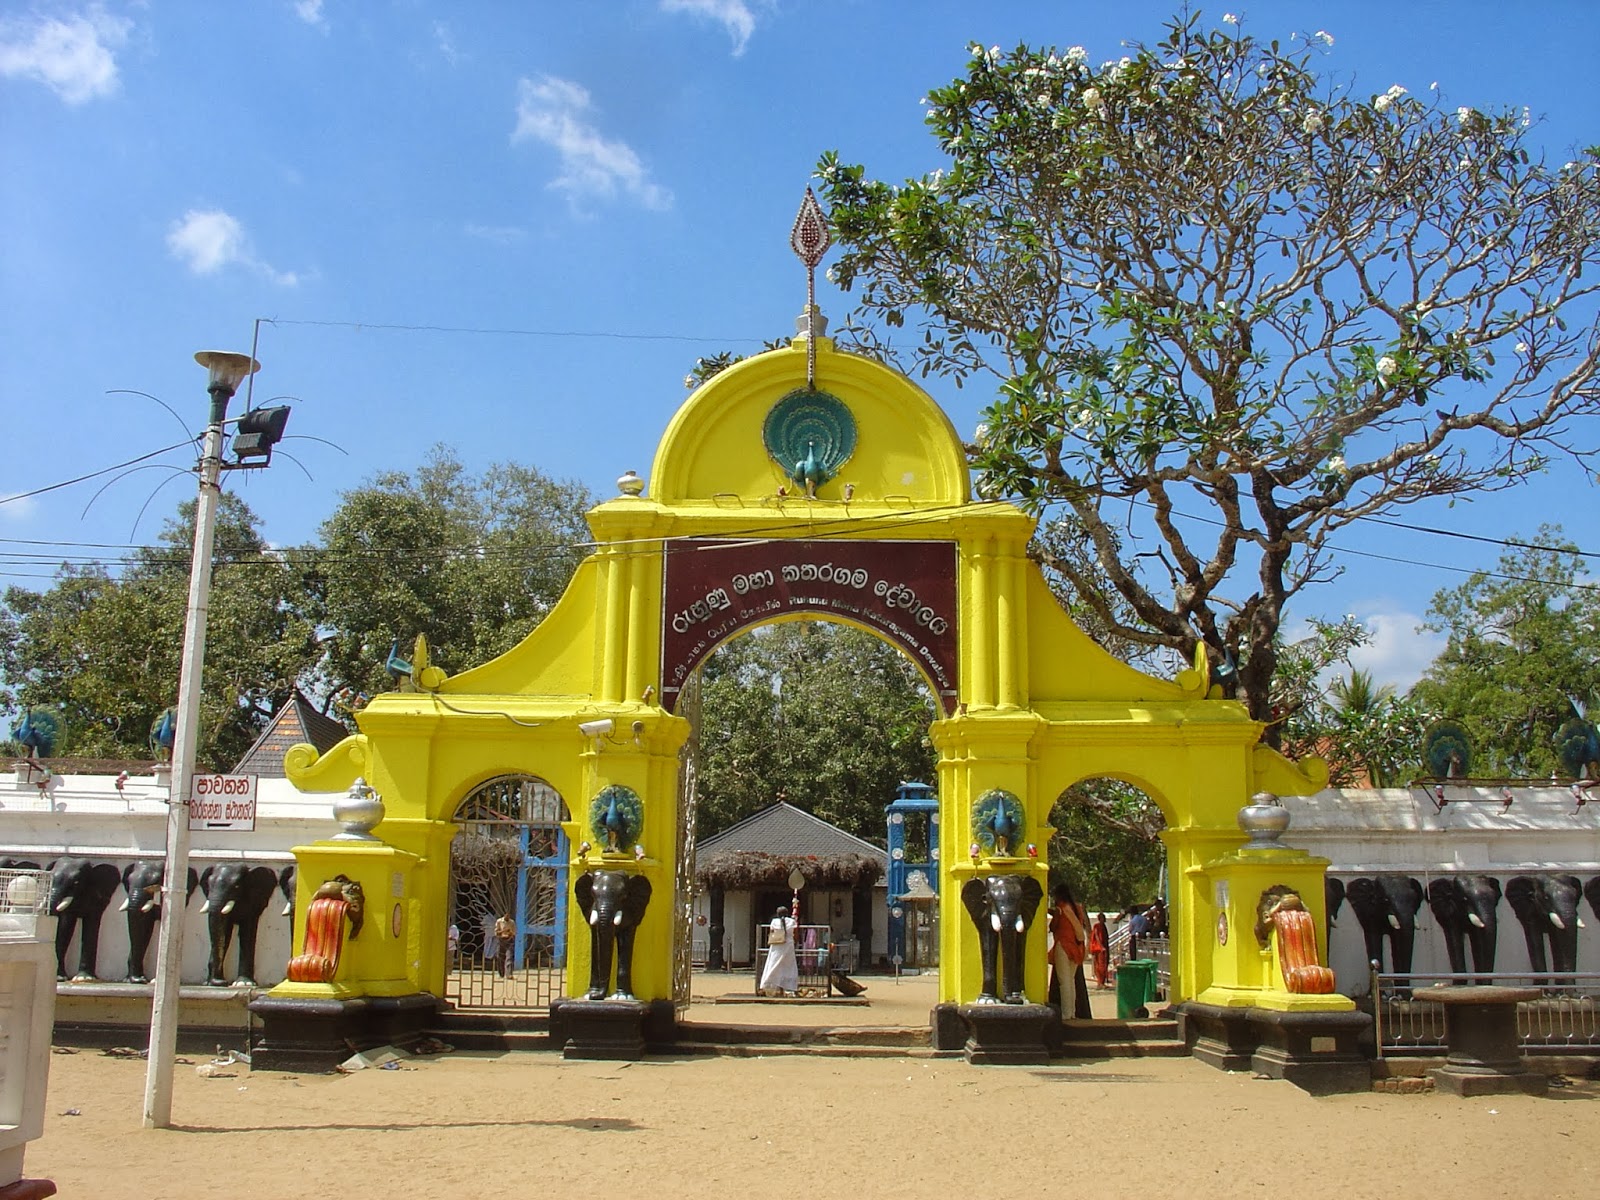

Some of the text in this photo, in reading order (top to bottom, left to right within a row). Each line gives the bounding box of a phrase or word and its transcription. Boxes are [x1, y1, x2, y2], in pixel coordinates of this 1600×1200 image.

[672, 562, 949, 636] රුහුණු මහා කතරගම දේවාලය
[197, 775, 250, 795] පාවහන්
